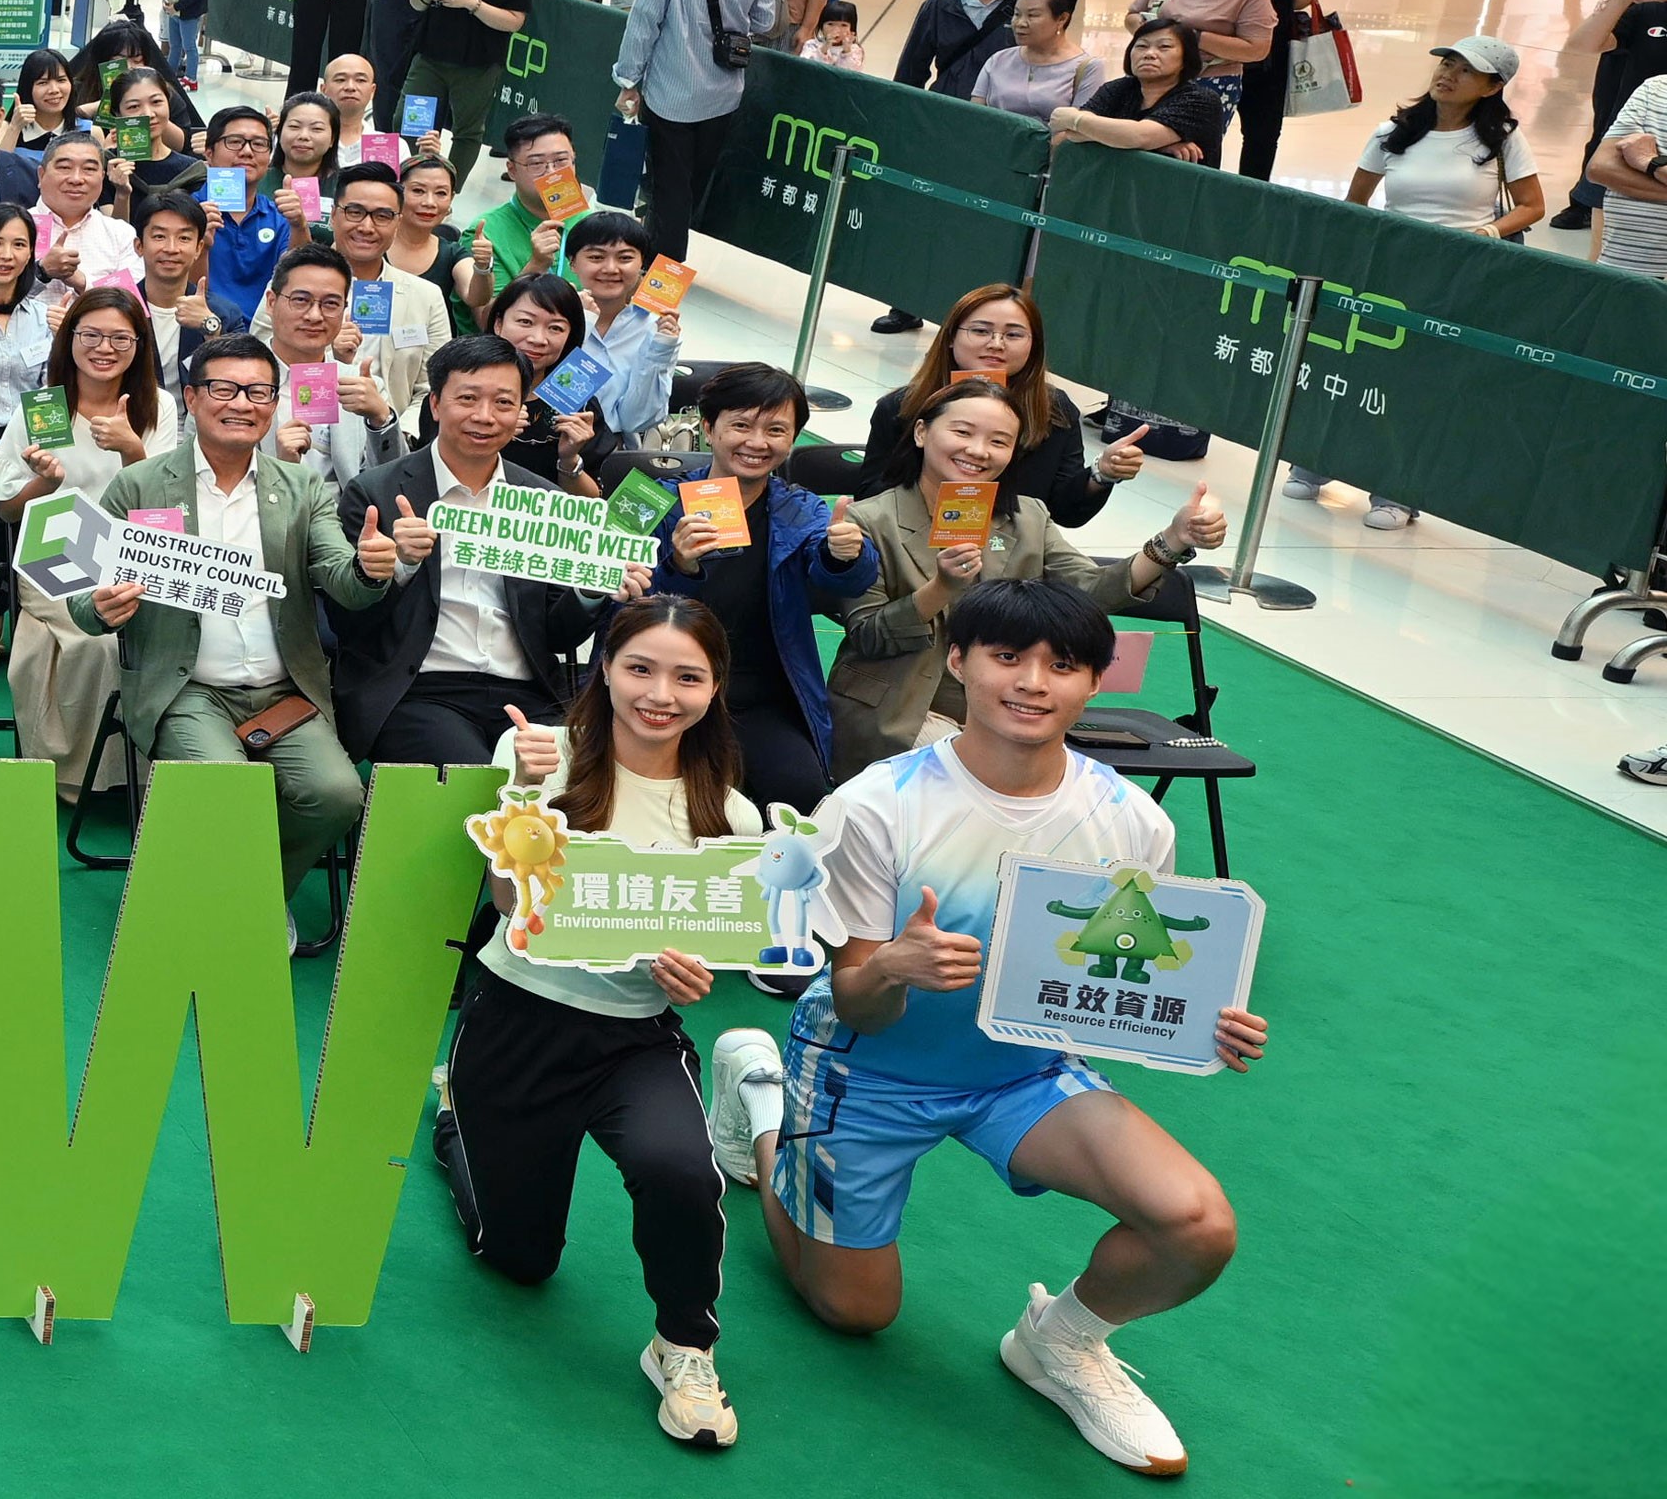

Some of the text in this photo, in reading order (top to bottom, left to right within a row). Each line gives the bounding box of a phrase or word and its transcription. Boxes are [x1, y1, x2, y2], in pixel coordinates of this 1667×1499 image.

[506, 32, 548, 79] CP
[761, 175, 863, 230] 新都城心
[1337, 295, 1374, 314] MCP
[1423, 318, 1461, 338] MCP
[1515, 344, 1555, 363] MCP
[1613, 369, 1656, 390] MCP
[491, 485, 604, 528] HONG KONG
[123, 527, 252, 566] CONSTRUCTION
[433, 504, 655, 565] GREEN BUILDING WEEK
[119, 546, 282, 597] INDUSTRY COUNCIL
[453, 541, 623, 591] 香港綠色建築週
[115, 567, 247, 618] 建造業議會
[571, 871, 743, 914] 環境友善
[553, 913, 763, 935] Environmental Friendliness
[1037, 978, 1189, 1026] 高效資源
[1044, 1008, 1177, 1042] Resource Efficiency
